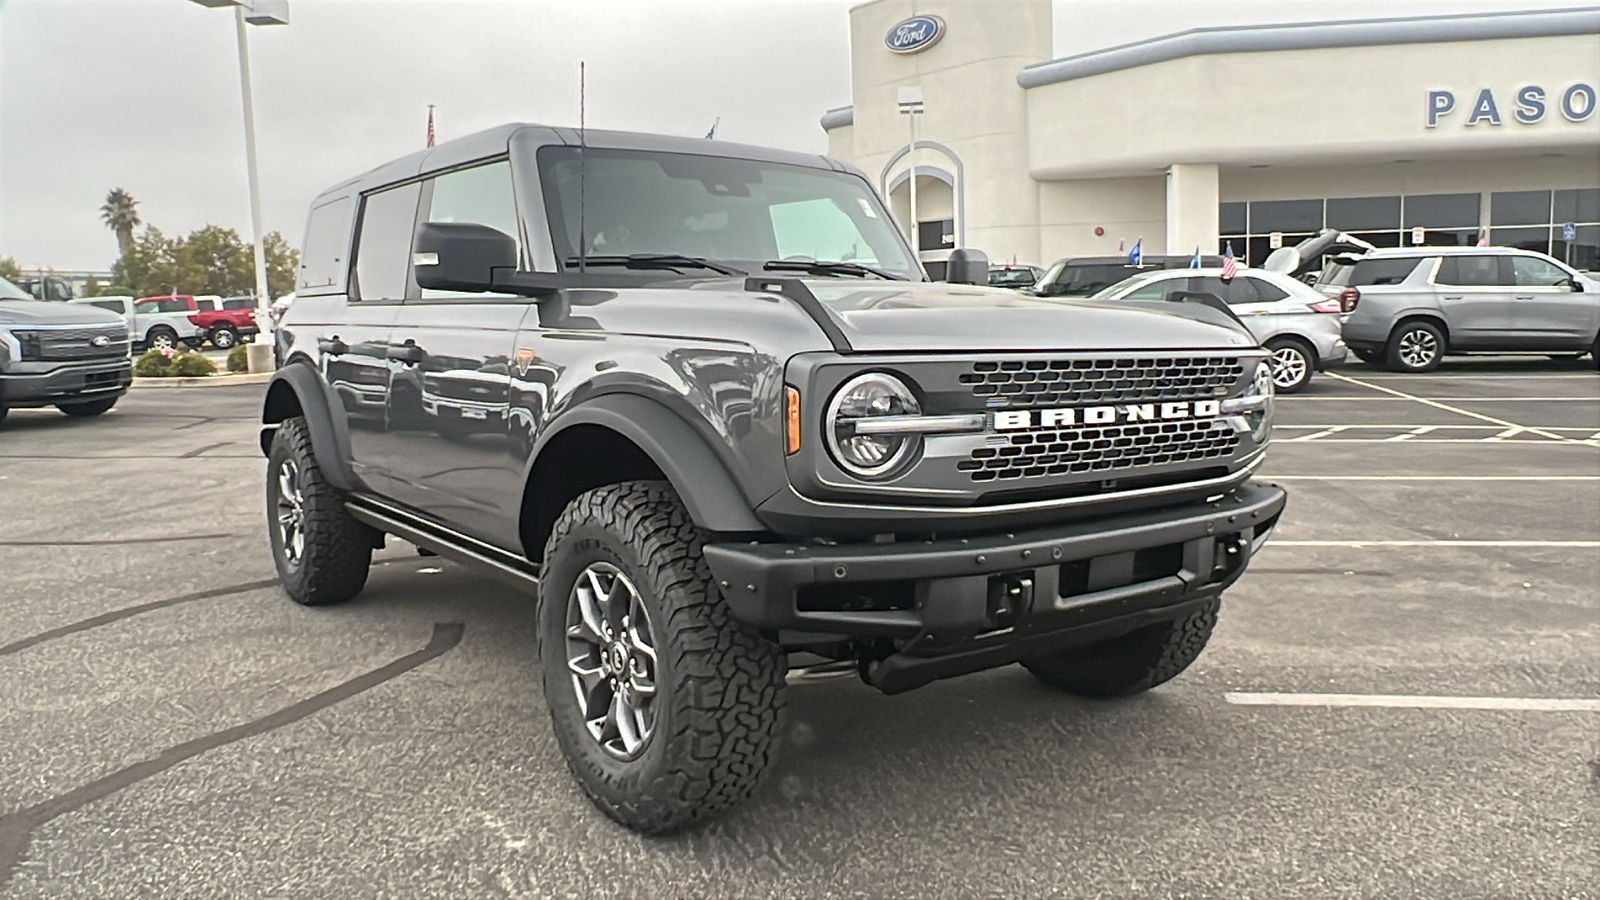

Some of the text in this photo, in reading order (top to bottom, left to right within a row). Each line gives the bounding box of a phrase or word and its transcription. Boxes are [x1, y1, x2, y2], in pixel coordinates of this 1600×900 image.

[894, 22, 926, 46] Ford
[1426, 83, 1598, 128] PASO
[993, 400, 1220, 430] BRONCO
